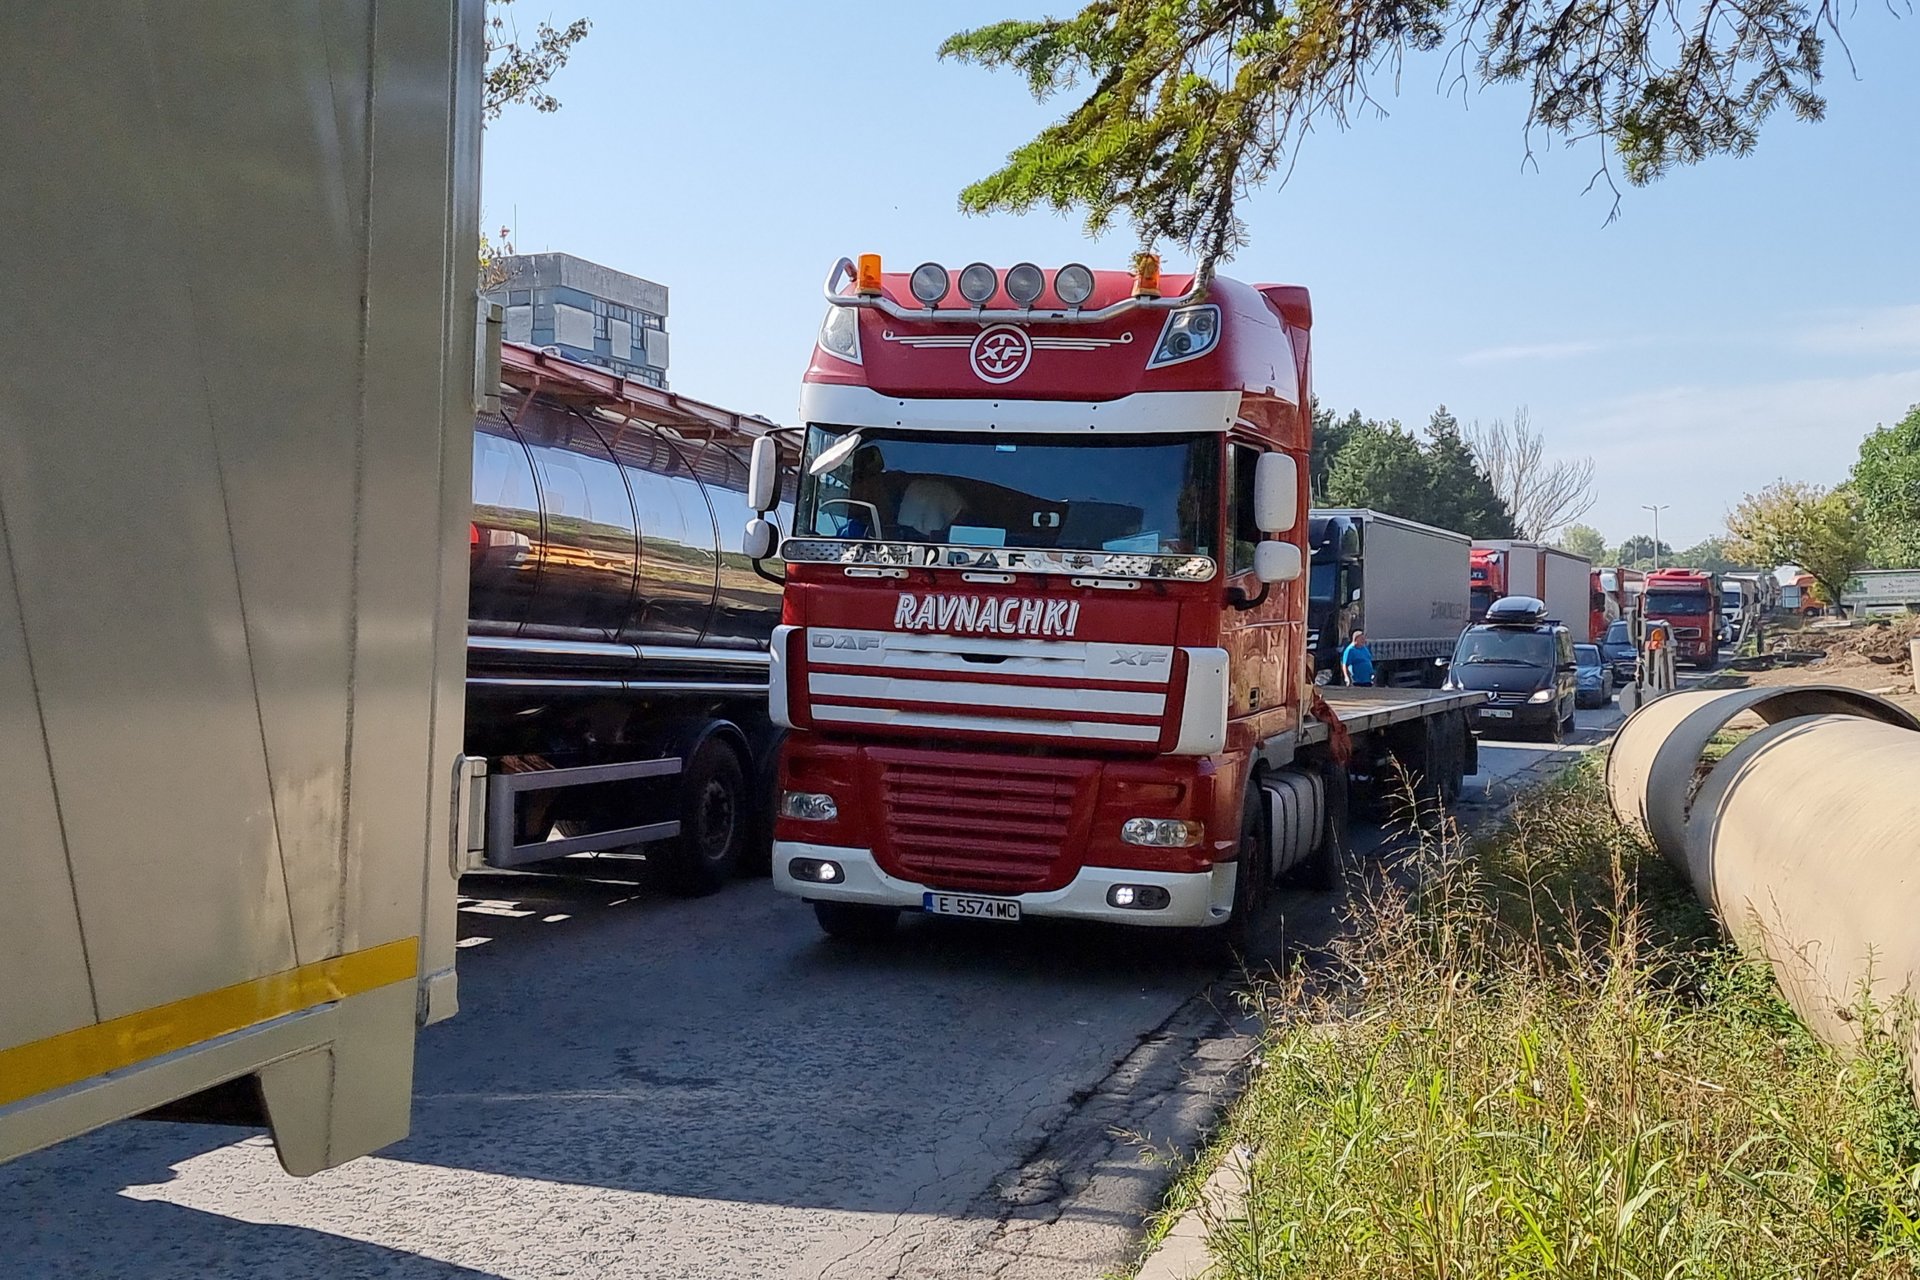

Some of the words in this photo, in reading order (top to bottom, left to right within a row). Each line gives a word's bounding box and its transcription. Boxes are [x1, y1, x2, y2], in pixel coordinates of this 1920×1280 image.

[976, 346, 1025, 360] XF
[894, 592, 1080, 637] RAVNACHKI
[812, 634, 880, 651] DAF
[1109, 650, 1168, 666] XF
[939, 897, 950, 912] E
[957, 899, 994, 917] 5574
[997, 902, 1017, 918] MC
